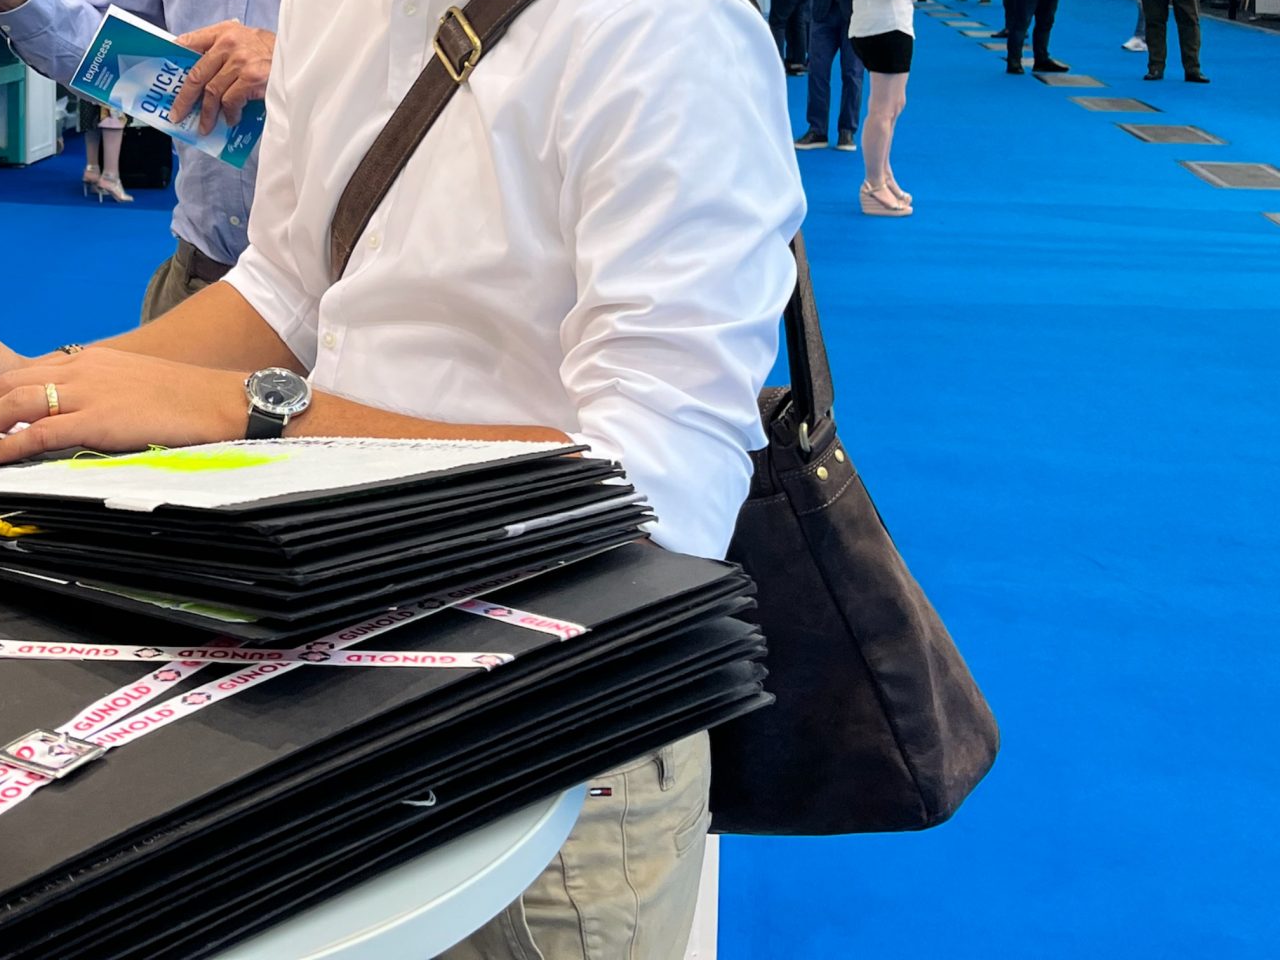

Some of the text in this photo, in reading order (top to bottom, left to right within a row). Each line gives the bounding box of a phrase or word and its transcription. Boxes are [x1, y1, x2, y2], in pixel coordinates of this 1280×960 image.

[82, 38, 113, 83] texprocess
[338, 610, 415, 641] GUNOLD
[18, 645, 119, 657] GUNOLD
[178, 649, 283, 660] GUNOLD
[346, 653, 456, 664] GUNOLD
[73, 683, 152, 732] GUNOLD
